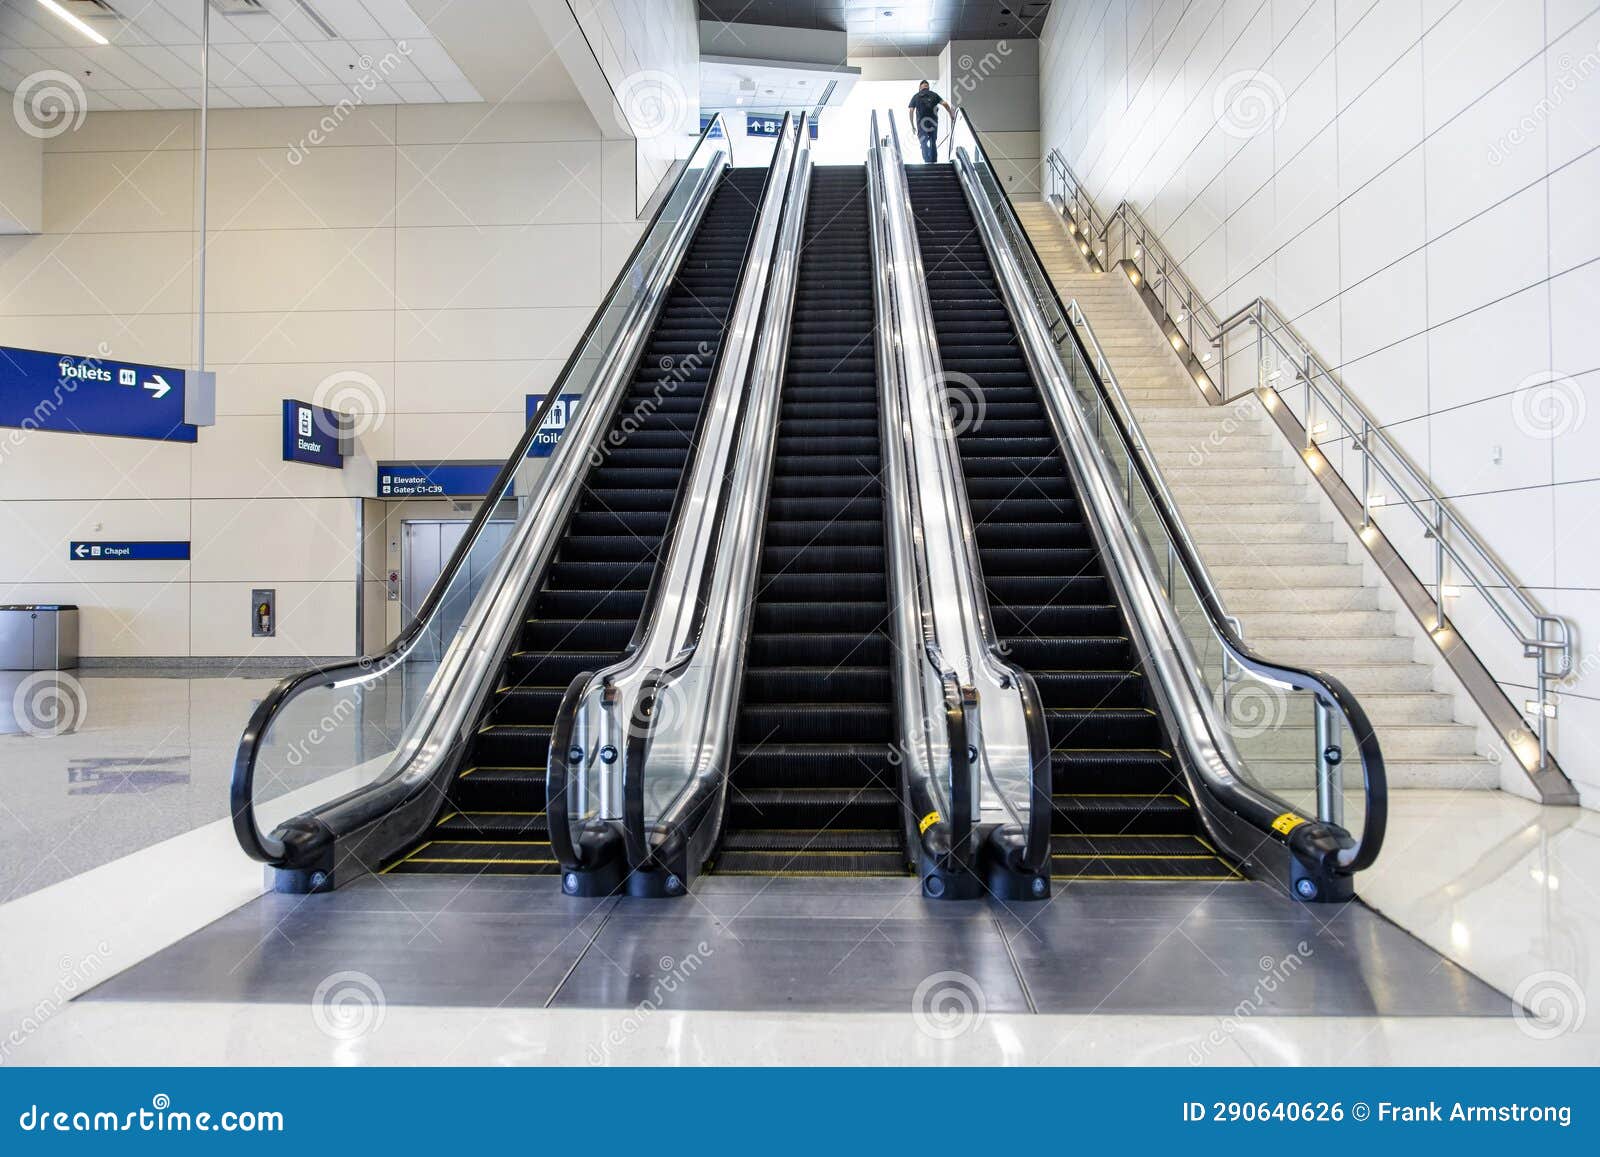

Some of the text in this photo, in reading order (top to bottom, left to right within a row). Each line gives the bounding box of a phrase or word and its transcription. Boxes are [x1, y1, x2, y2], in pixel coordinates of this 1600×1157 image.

[59, 363, 112, 382] Toilets
[298, 439, 321, 453] Elevator
[104, 547, 130, 556] Chapel
